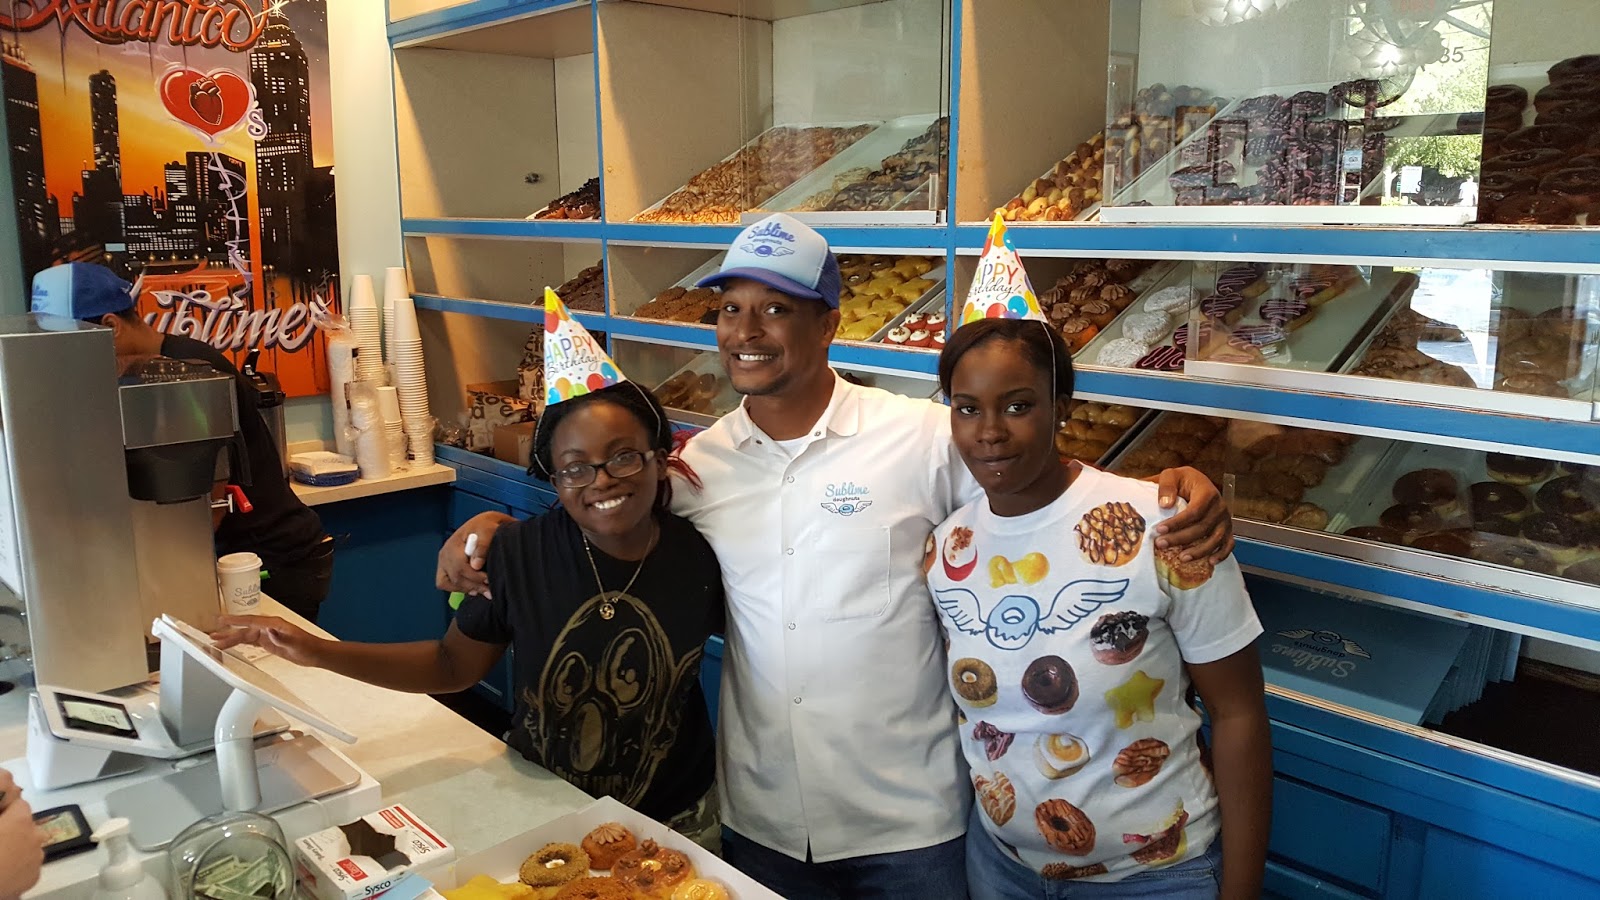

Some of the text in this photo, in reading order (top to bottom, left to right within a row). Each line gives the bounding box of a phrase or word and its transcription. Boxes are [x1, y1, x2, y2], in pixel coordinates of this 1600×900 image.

[747, 221, 795, 243] Sublime
[974, 262, 1019, 285] APPY
[967, 276, 1022, 301] irthday!
[141, 288, 333, 351] ublime
[546, 335, 595, 366] HAPPY
[825, 481, 870, 498] Sublime
[1271, 643, 1357, 678] Sublime
[1293, 641, 1346, 658] doughnuts
[364, 879, 392, 897] Sysco
